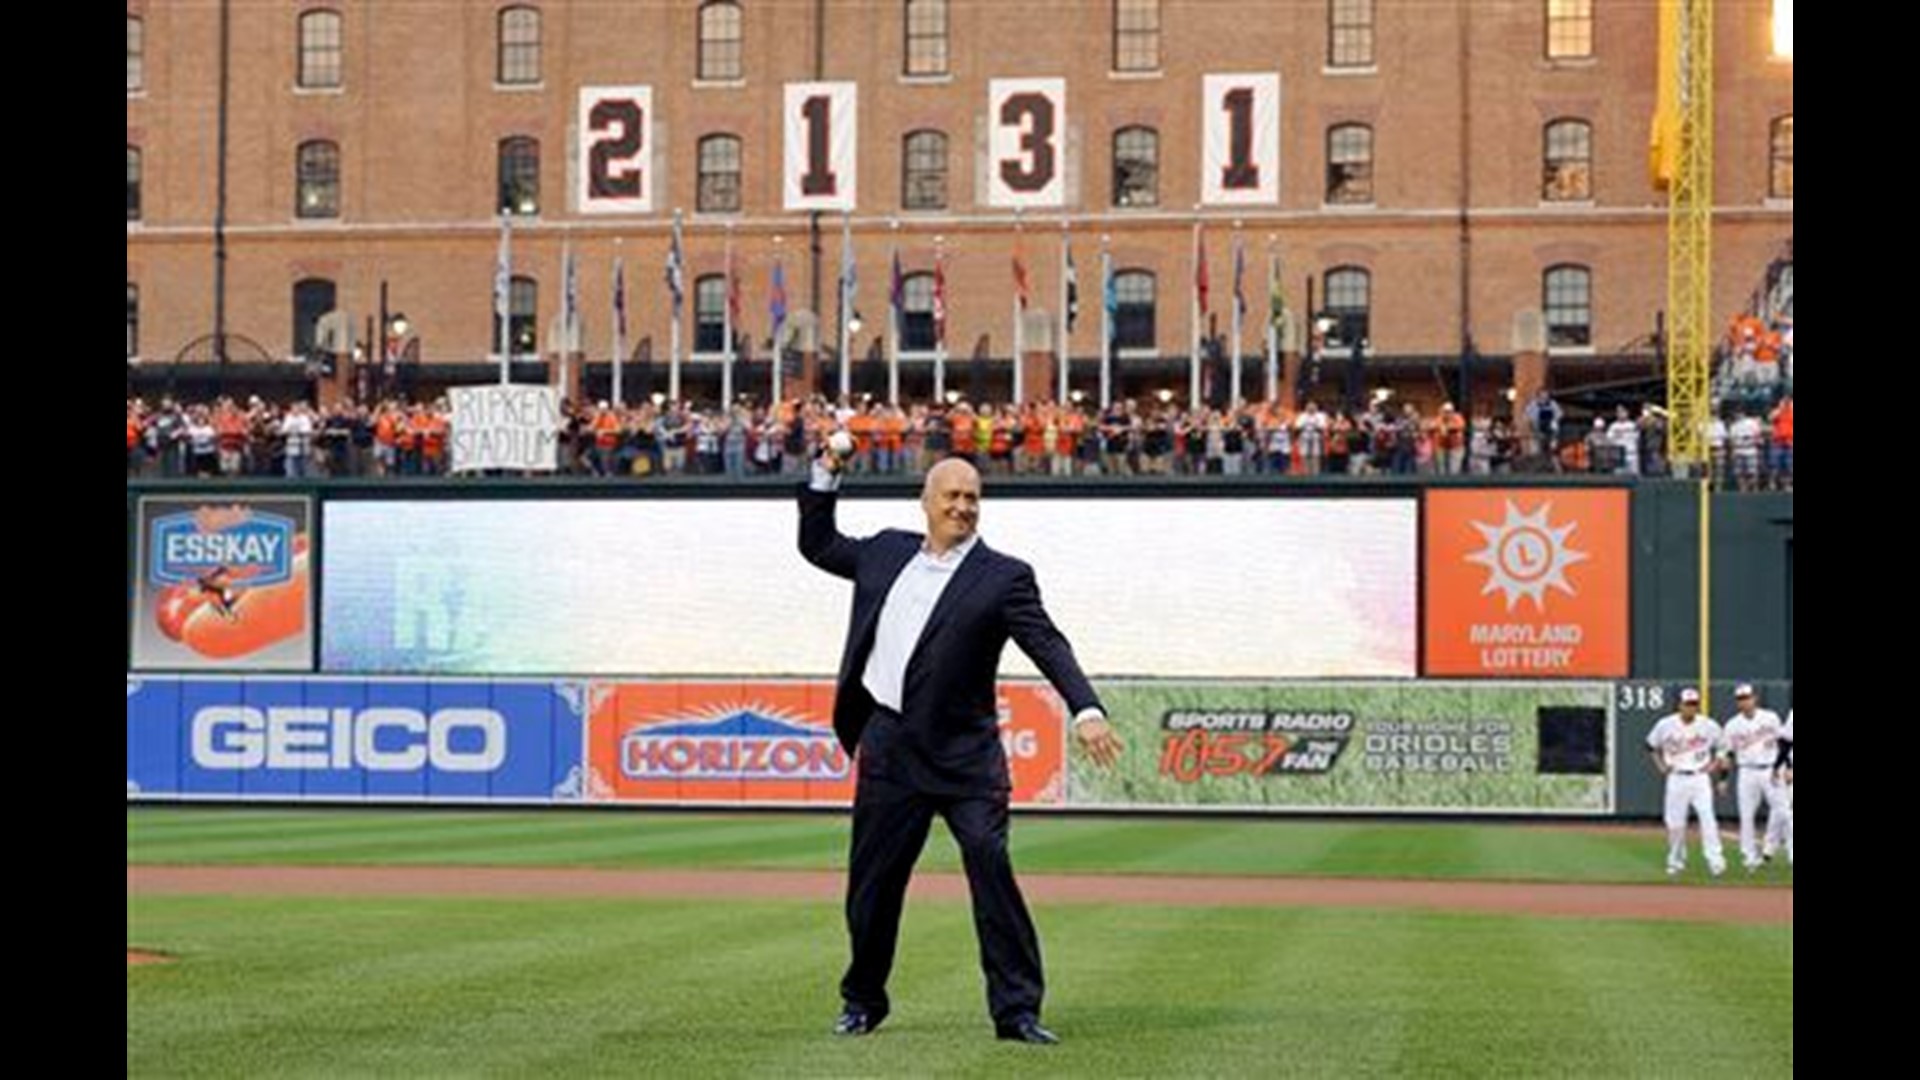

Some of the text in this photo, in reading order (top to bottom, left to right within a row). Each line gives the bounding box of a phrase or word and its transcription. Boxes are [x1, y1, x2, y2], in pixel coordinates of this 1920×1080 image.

[588, 87, 1260, 200] 2 1 3 1
[457, 389, 556, 427] RIPKEN
[454, 426, 557, 466] STADIUM
[166, 532, 281, 564] ESSKAY
[1470, 623, 1582, 644] MARYLAND
[1481, 648, 1572, 668] LOTTERY
[1618, 685, 1664, 710] 318
[1167, 712, 1352, 731] SPORTS RADIO
[191, 706, 506, 771] GEICO
[1365, 734, 1512, 753] ORIOLES
[627, 738, 846, 773] HORIZON
[1281, 753, 1333, 770] FAN
[1365, 754, 1512, 773] BASEBALL
